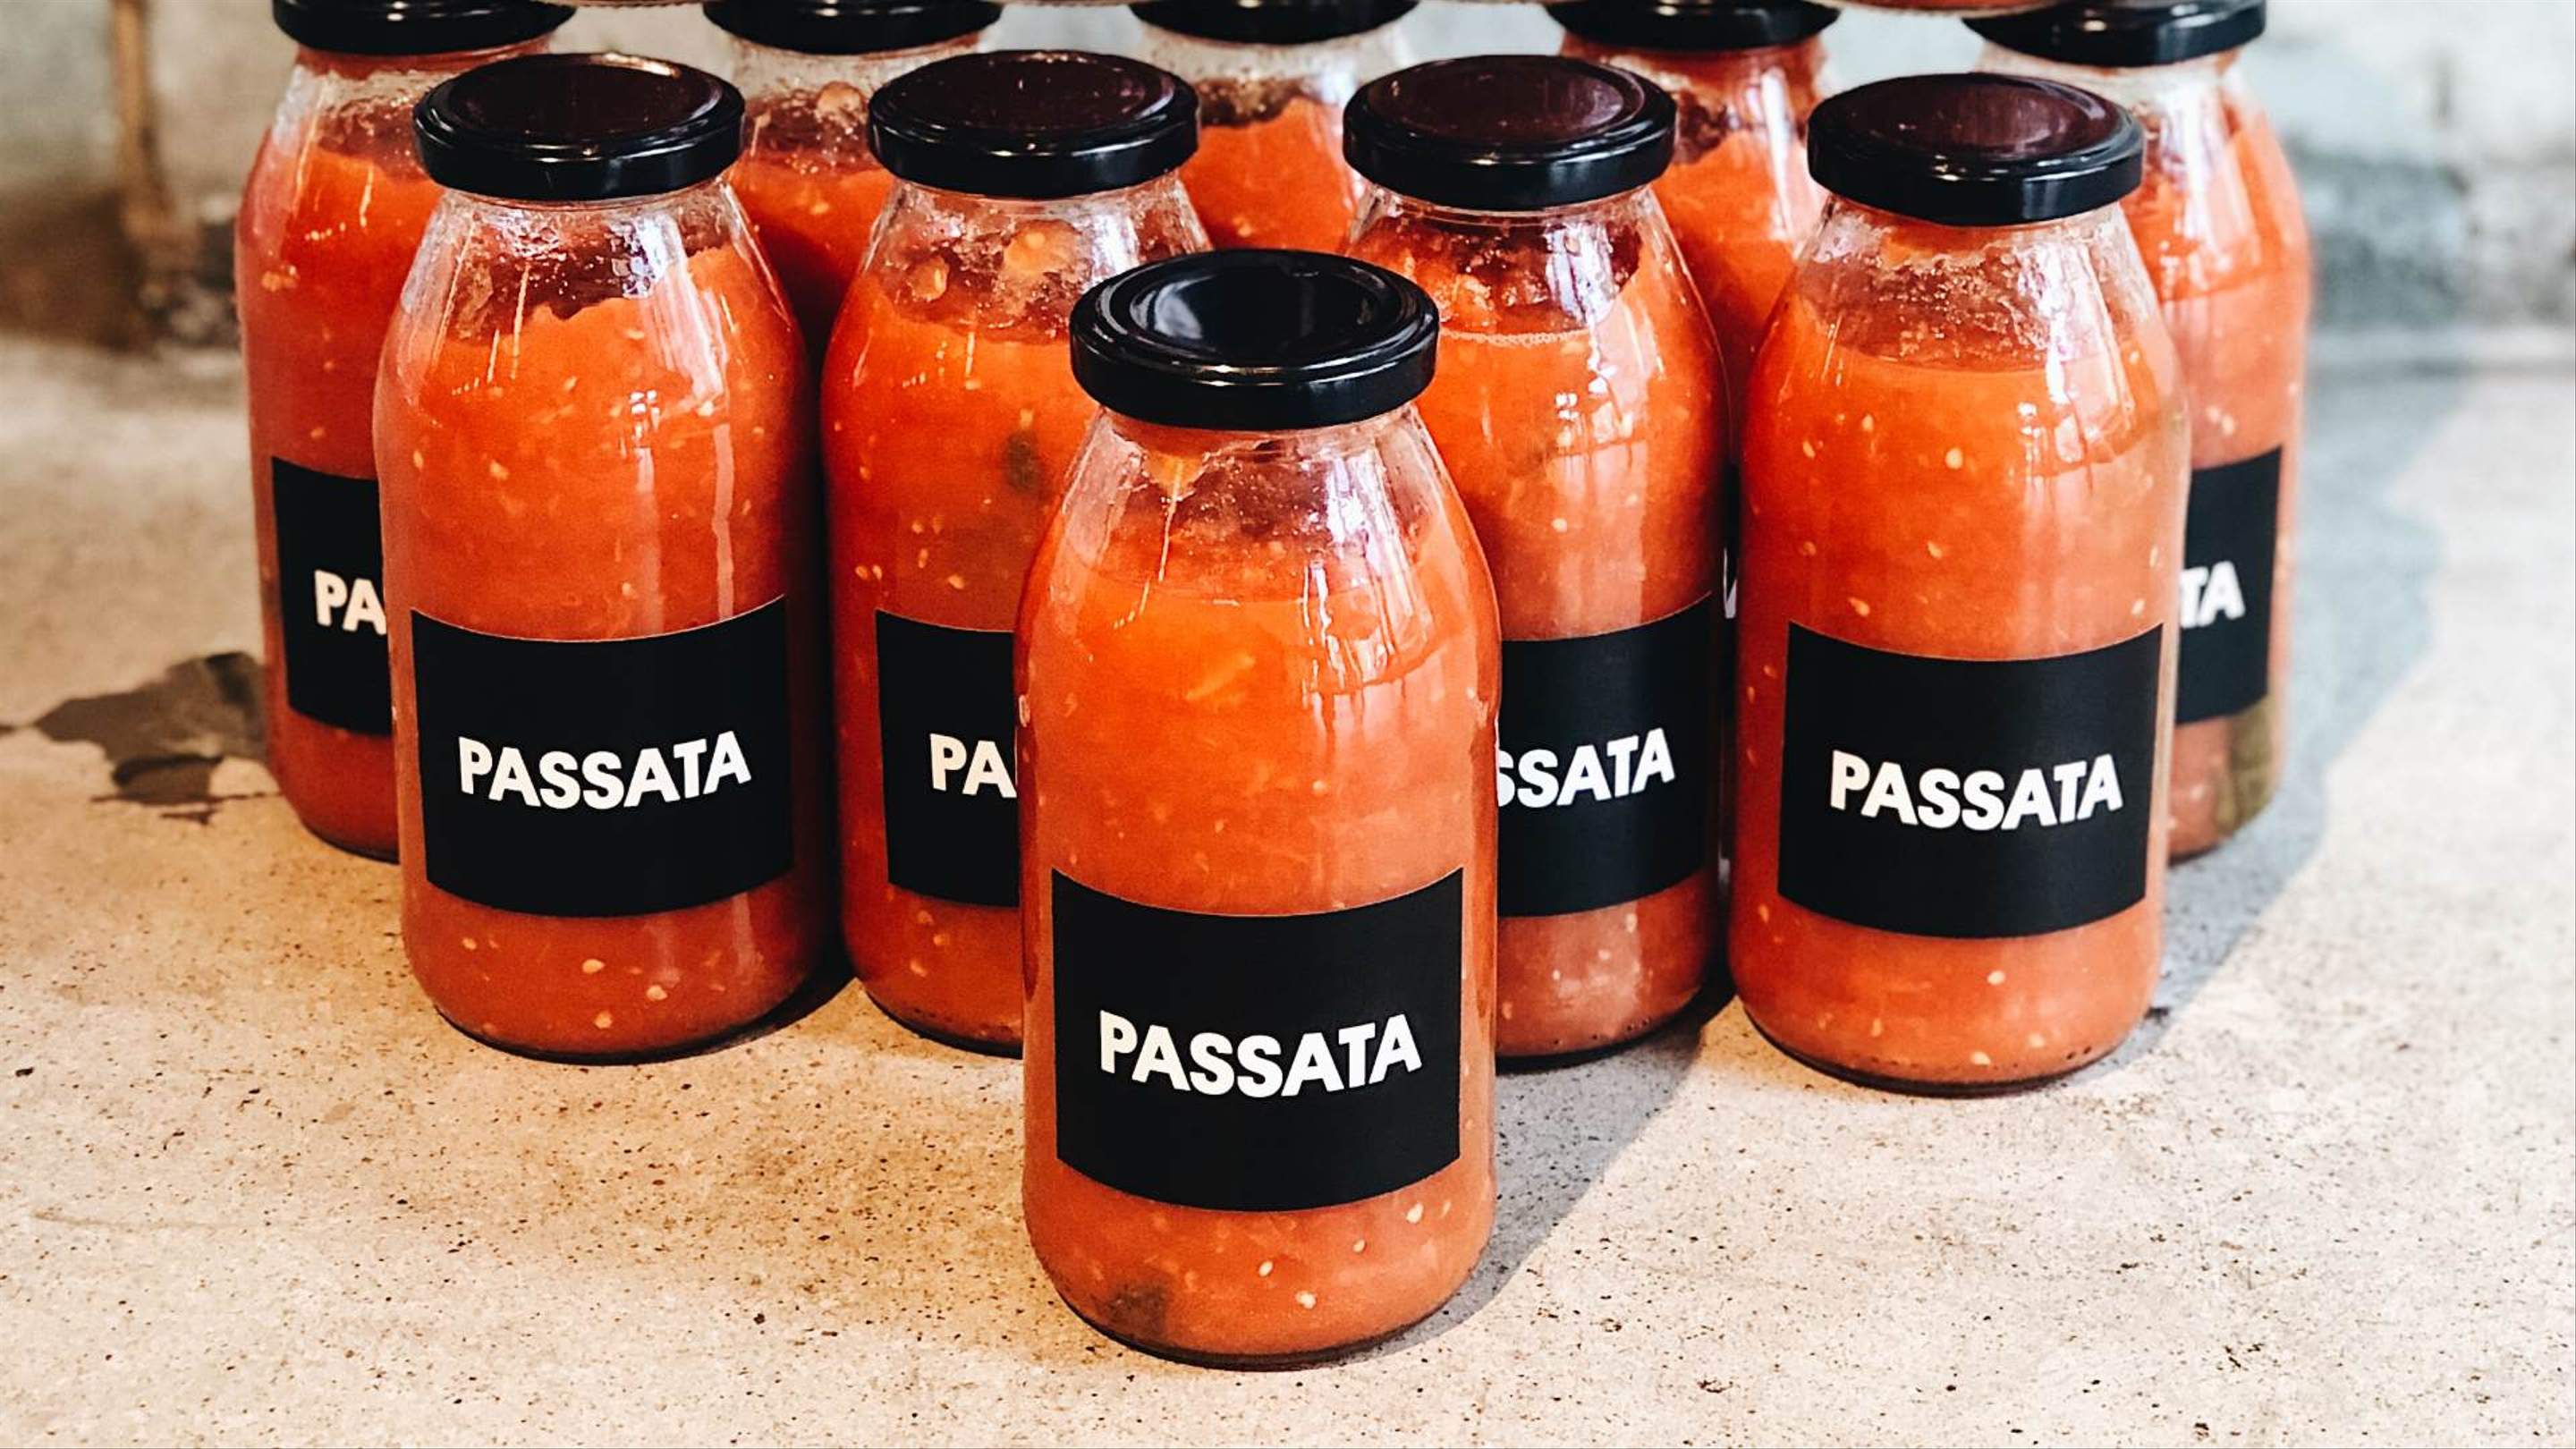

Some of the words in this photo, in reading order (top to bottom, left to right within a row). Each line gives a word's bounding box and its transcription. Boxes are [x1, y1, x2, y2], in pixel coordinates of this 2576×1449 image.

[458, 730, 752, 809] PASSATA
[1830, 750, 2123, 831] PASSATA
[1099, 1010, 1422, 1098] PASSATA
